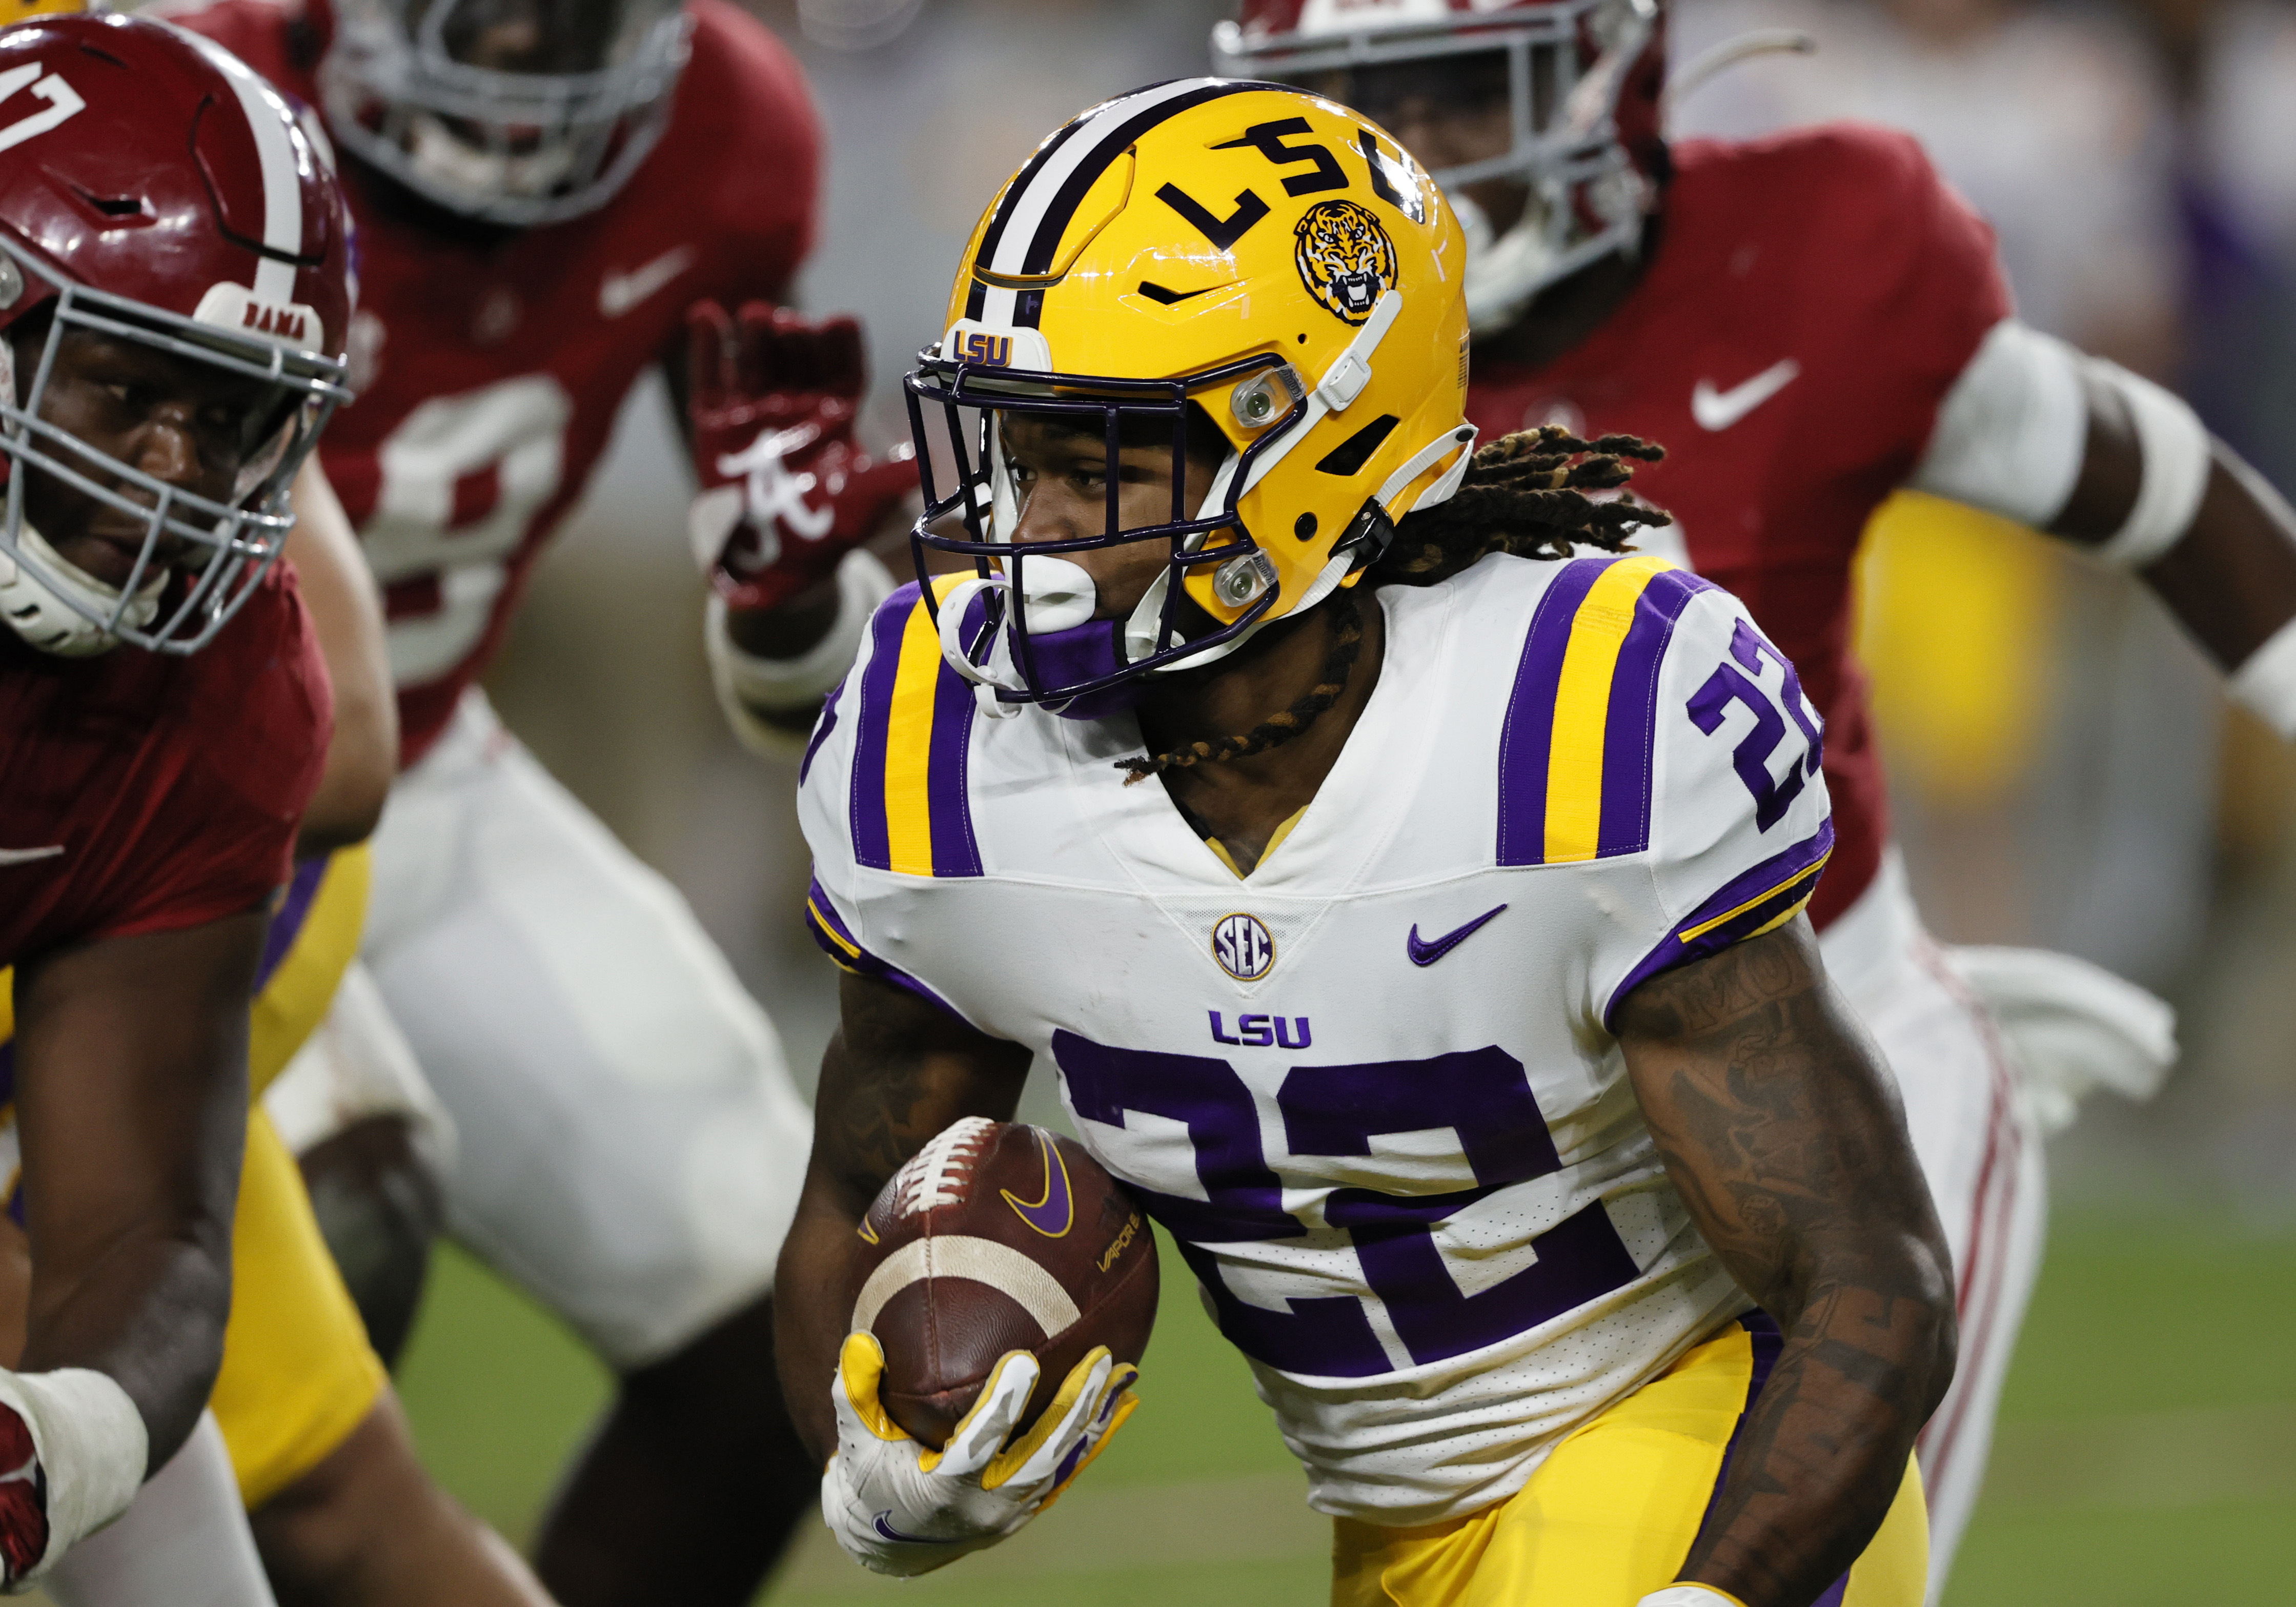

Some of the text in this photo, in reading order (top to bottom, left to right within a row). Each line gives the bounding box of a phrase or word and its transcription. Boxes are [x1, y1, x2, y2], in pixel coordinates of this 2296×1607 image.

[1154, 116, 1426, 252] LSU
[953, 330, 1013, 368] LSU
[1216, 917, 1269, 975] SEC
[1208, 1010, 1312, 1049] LSU
[1051, 1027, 1641, 1378] 22
